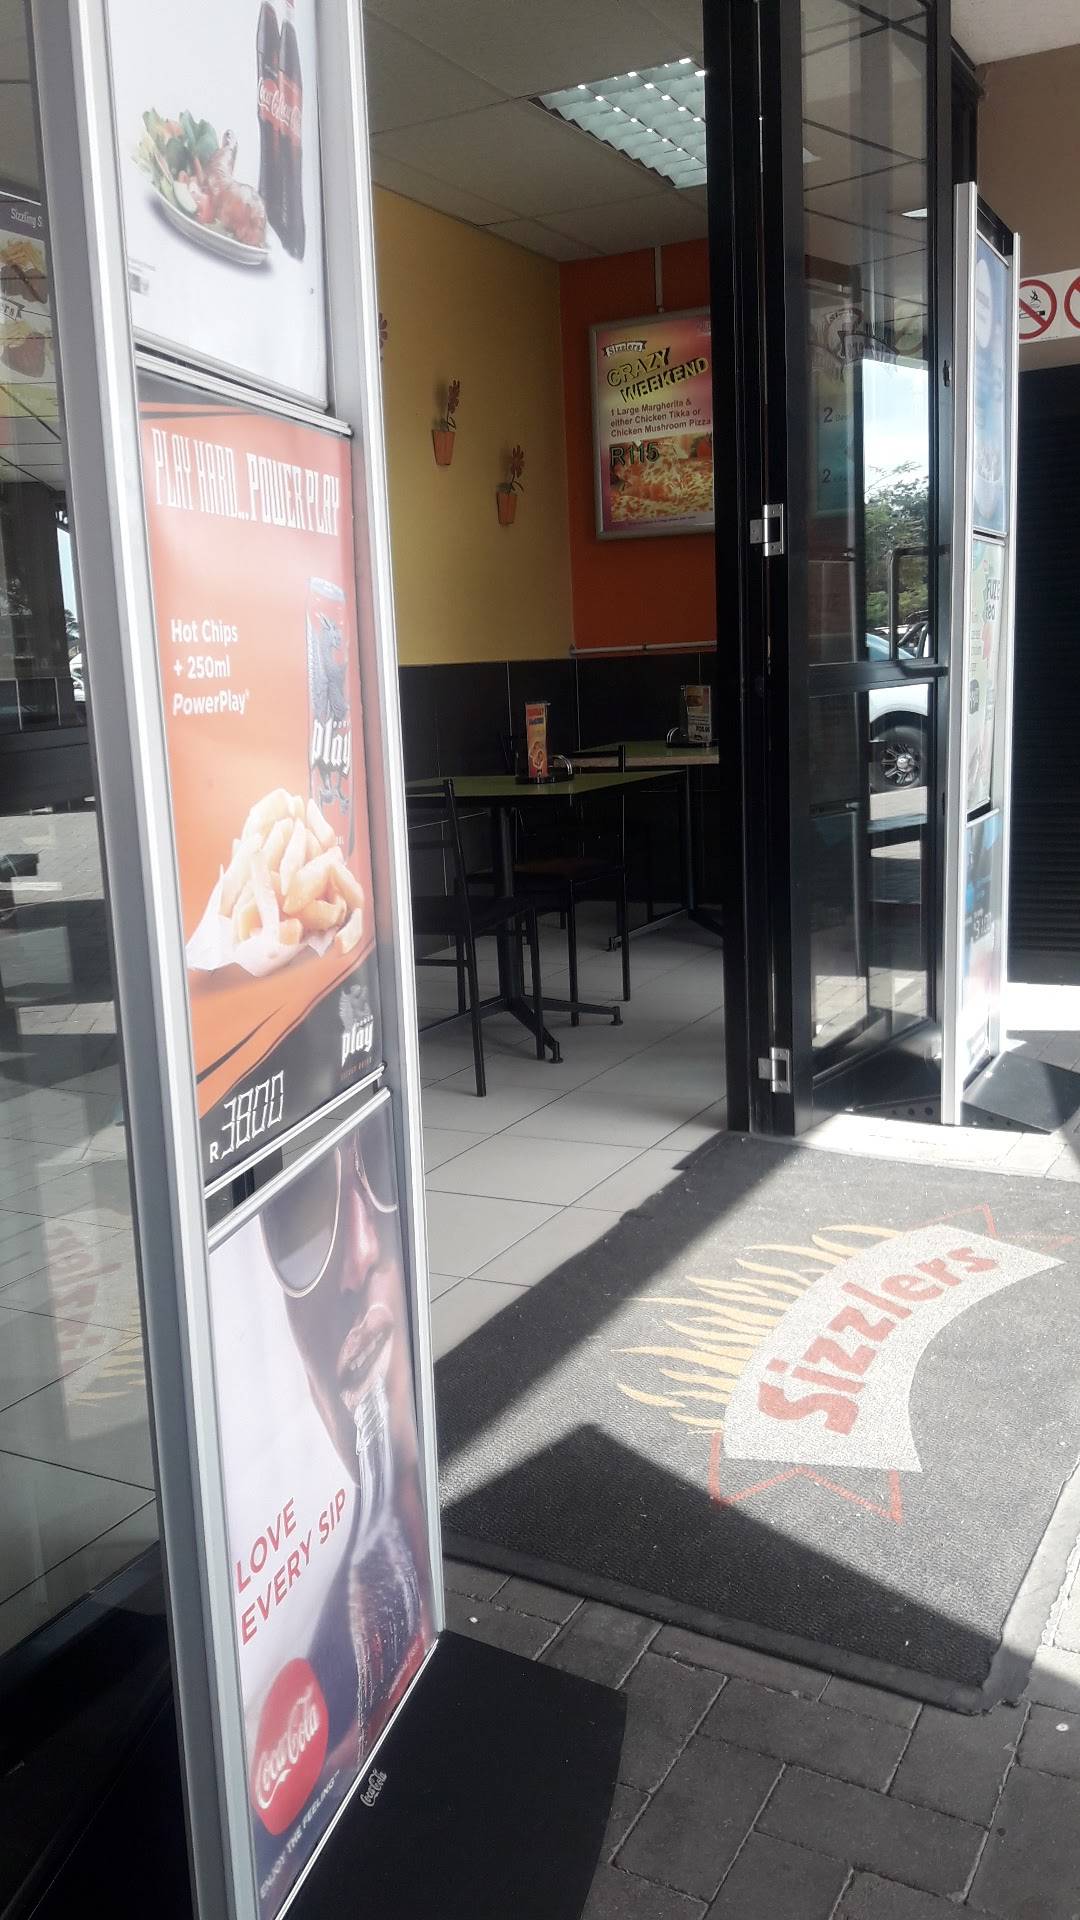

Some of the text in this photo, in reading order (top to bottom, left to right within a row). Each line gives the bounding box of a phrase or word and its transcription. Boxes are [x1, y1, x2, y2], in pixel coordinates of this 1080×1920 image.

[10, 207, 37, 229] Sizzling
[608, 343, 642, 355] Sizzlers
[607, 345, 671, 387] CRAZY
[620, 357, 709, 403] WEEKEND
[610, 398, 692, 417] 1 Large Margherita &
[610, 408, 701, 428] either Chicken Tikka or
[823, 406, 833, 423] 2
[610, 418, 711, 438] Chicken Mushroom Pizza
[610, 442, 660, 466] R115
[151, 428, 194, 511] PLAY
[171, 618, 239, 647] Hot Chips
[173, 654, 231, 680] + 250ml
[311, 718, 352, 776] play
[341, 1022, 373, 1069] play
[756, 1246, 1000, 1436] Sizzlers
[235, 1497, 297, 1594] LOVE
[241, 1488, 346, 1646] EVERY SIP
[286, 1829, 303, 1853] THE
